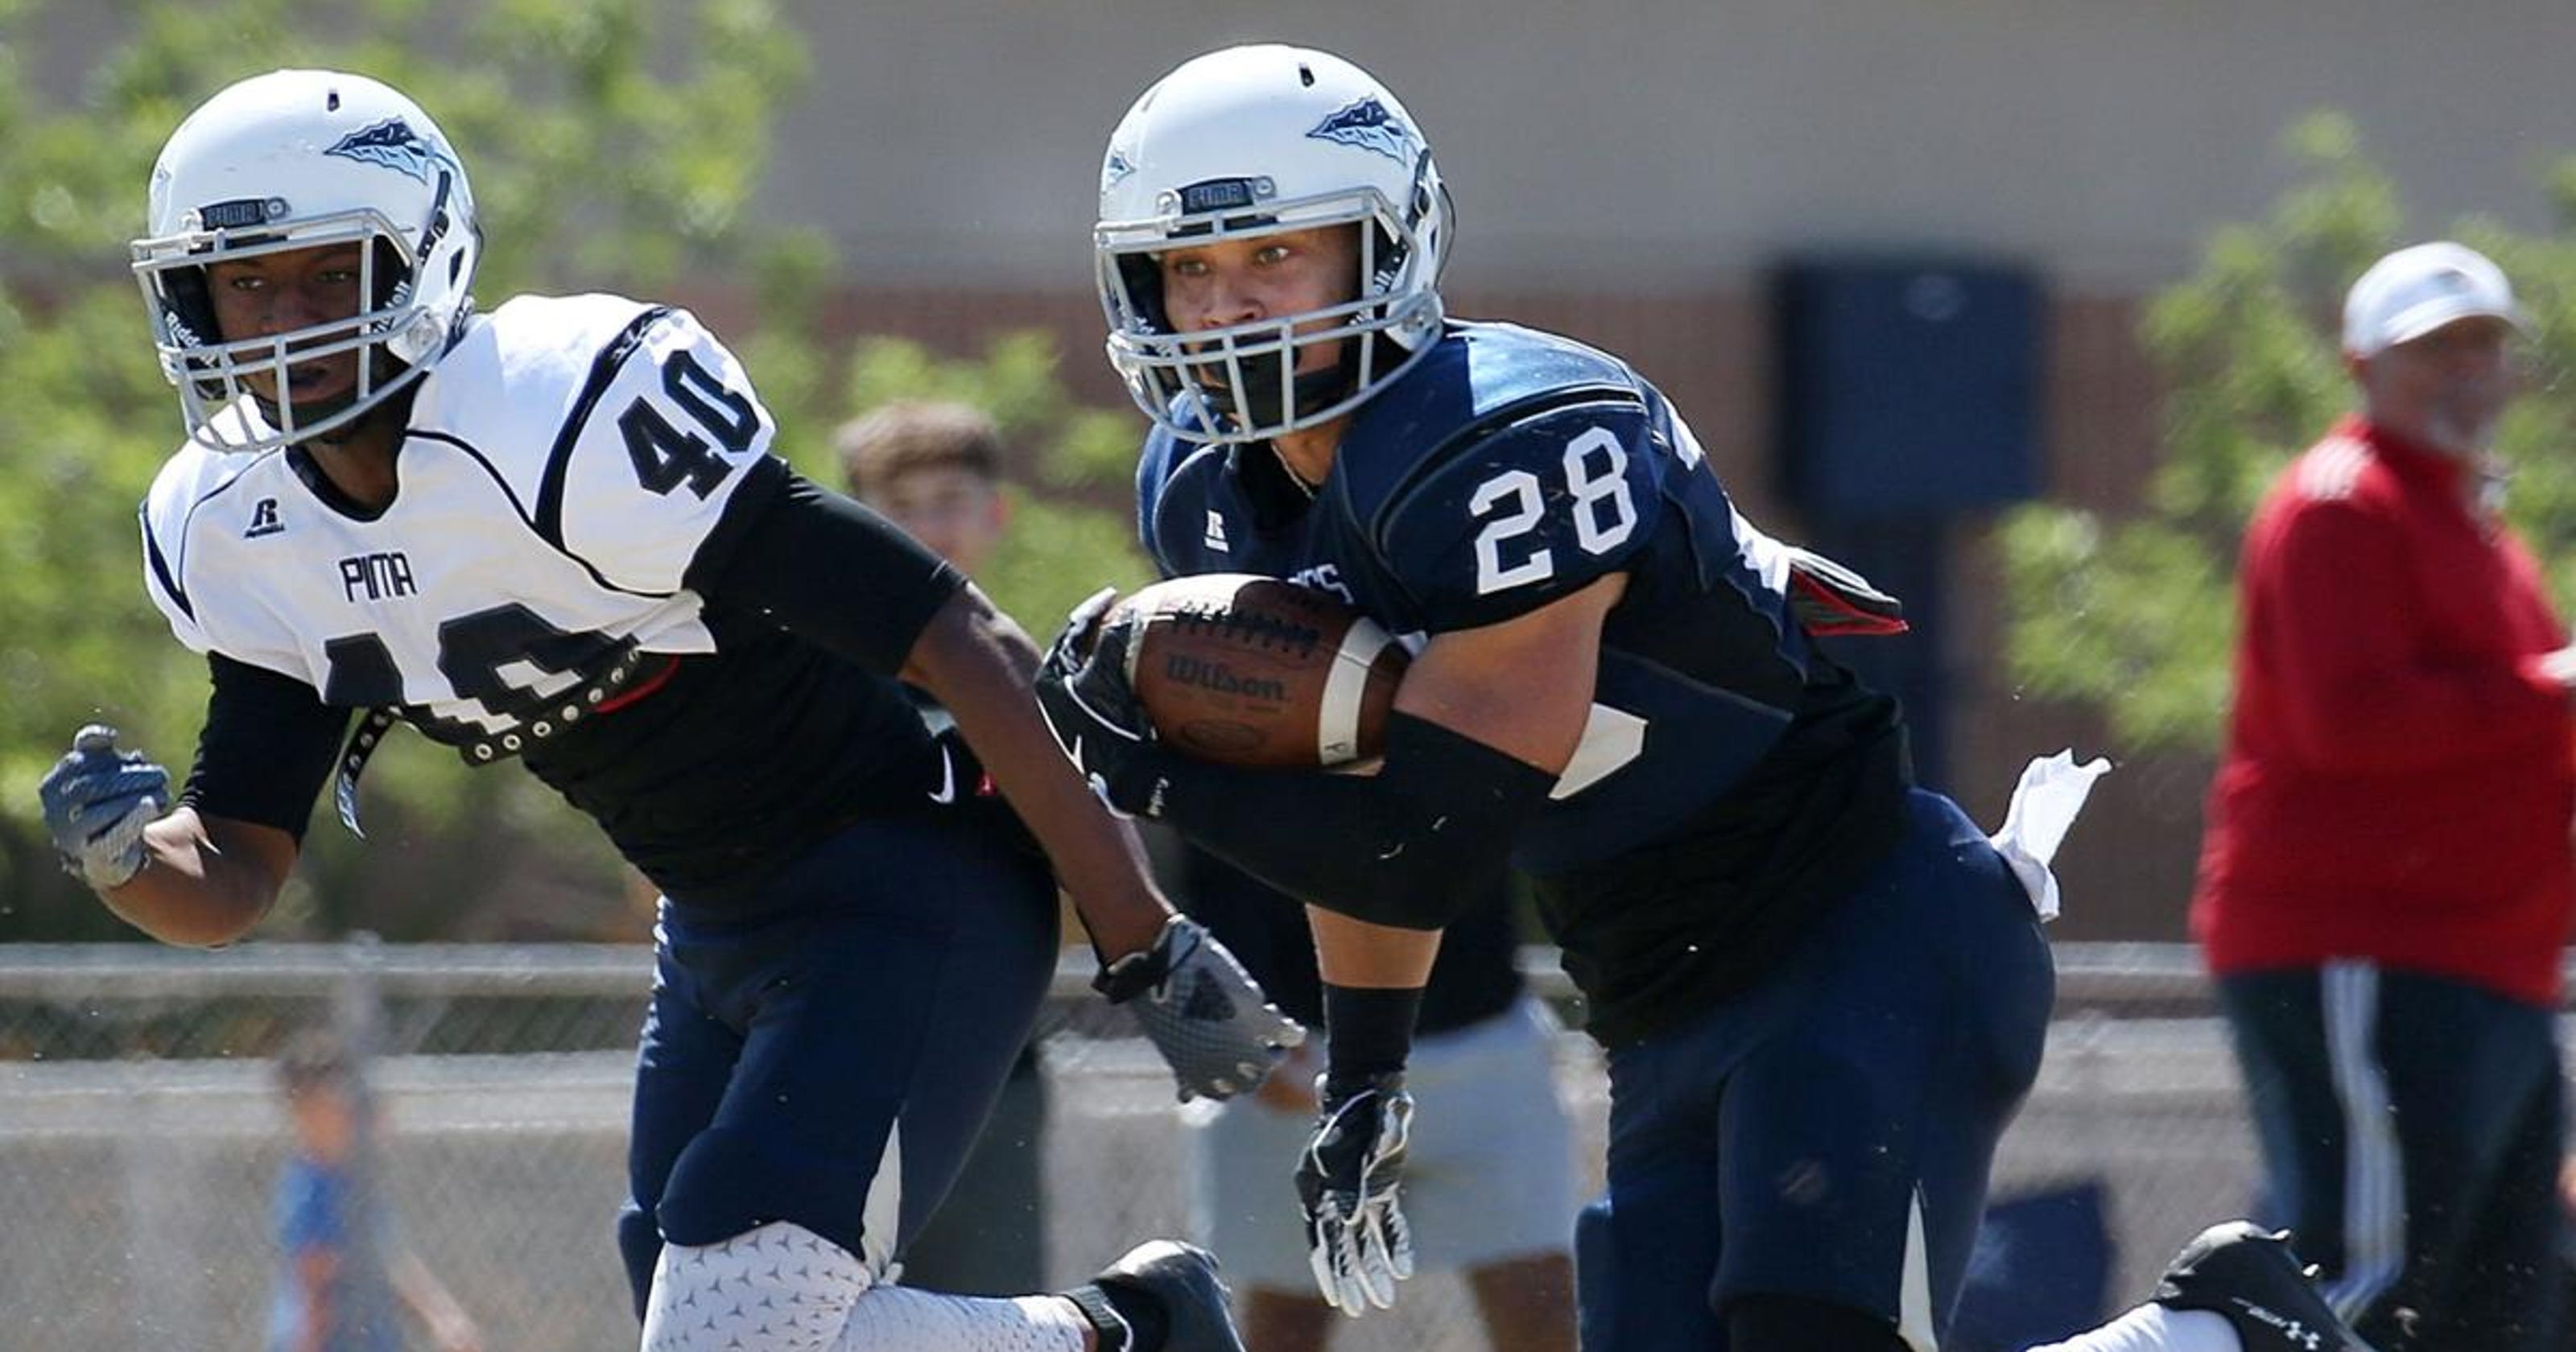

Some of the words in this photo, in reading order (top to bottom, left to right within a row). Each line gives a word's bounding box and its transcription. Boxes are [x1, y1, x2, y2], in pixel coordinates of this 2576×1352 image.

[617, 349, 761, 501] 40
[1468, 426, 1637, 595] 28
[339, 552, 417, 603] PIMA
[1166, 652, 1286, 702] Wilson
